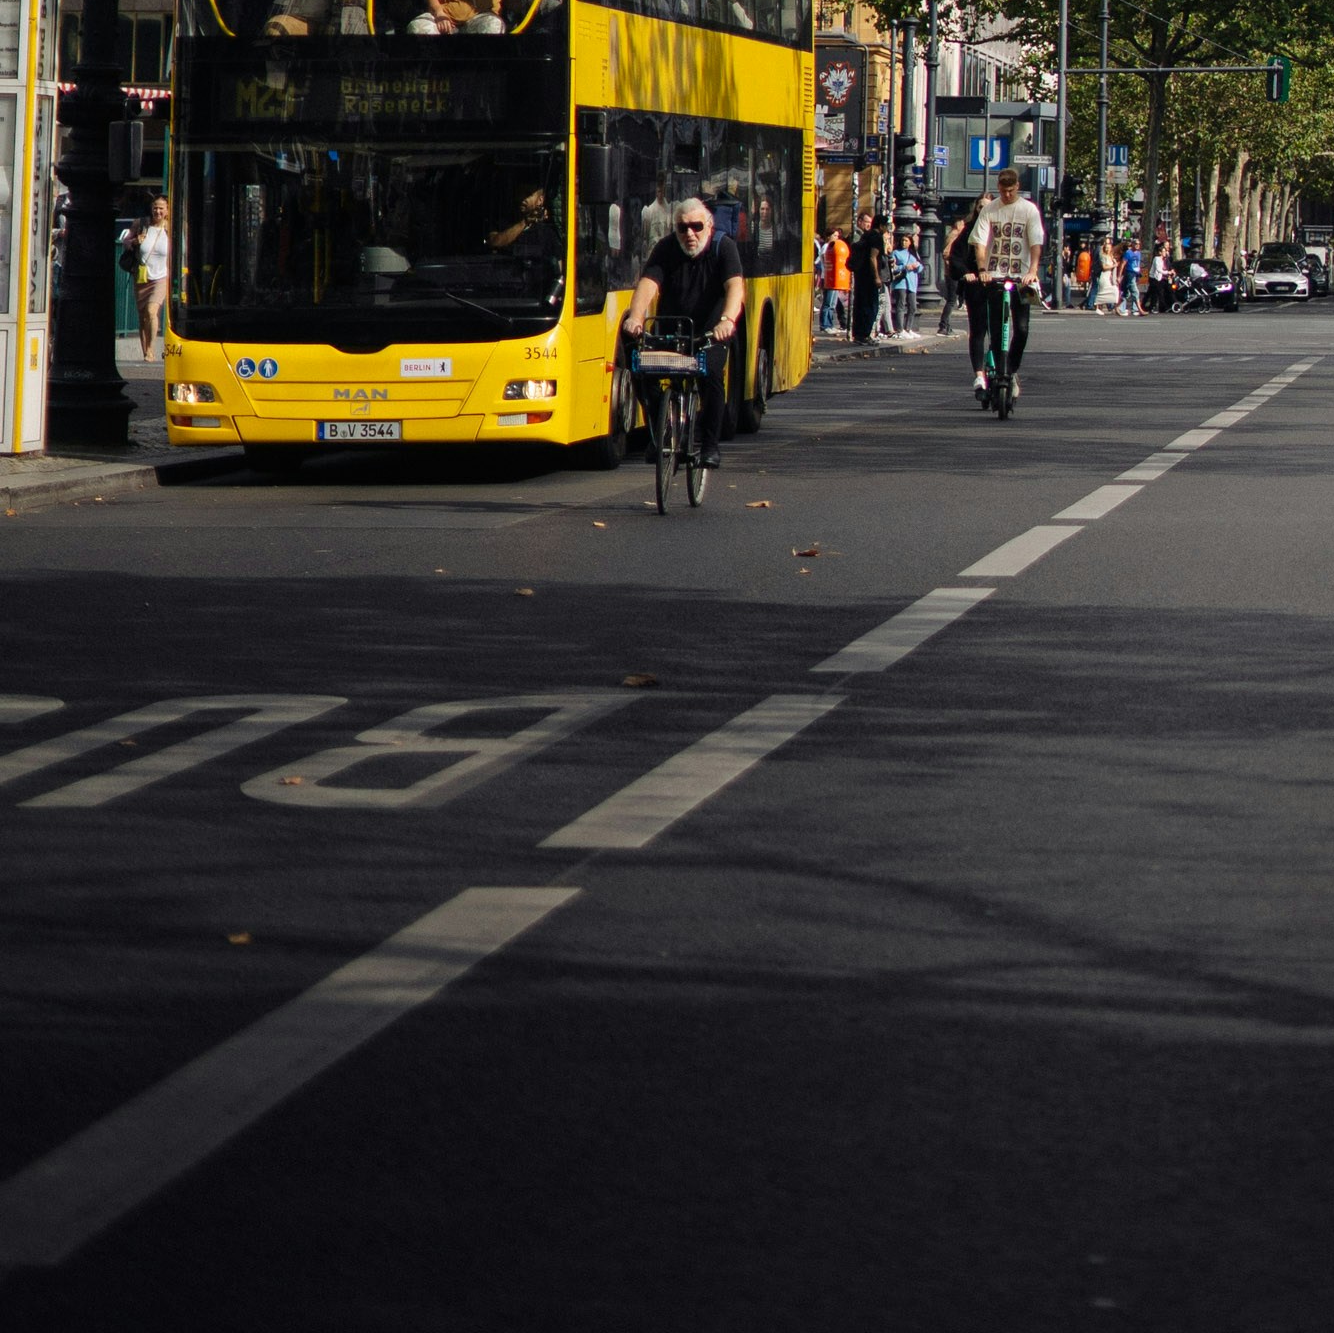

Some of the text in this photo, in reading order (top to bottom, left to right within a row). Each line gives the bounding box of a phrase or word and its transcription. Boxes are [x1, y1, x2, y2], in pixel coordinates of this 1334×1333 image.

[344, 96, 446, 114] Roseneck
[978, 140, 1001, 168] U
[1120, 147, 1128, 164] U
[1041, 168, 1048, 185] U
[523, 347, 558, 359] 3544
[333, 388, 388, 400] MAN
[330, 424, 393, 437] B V 3544
